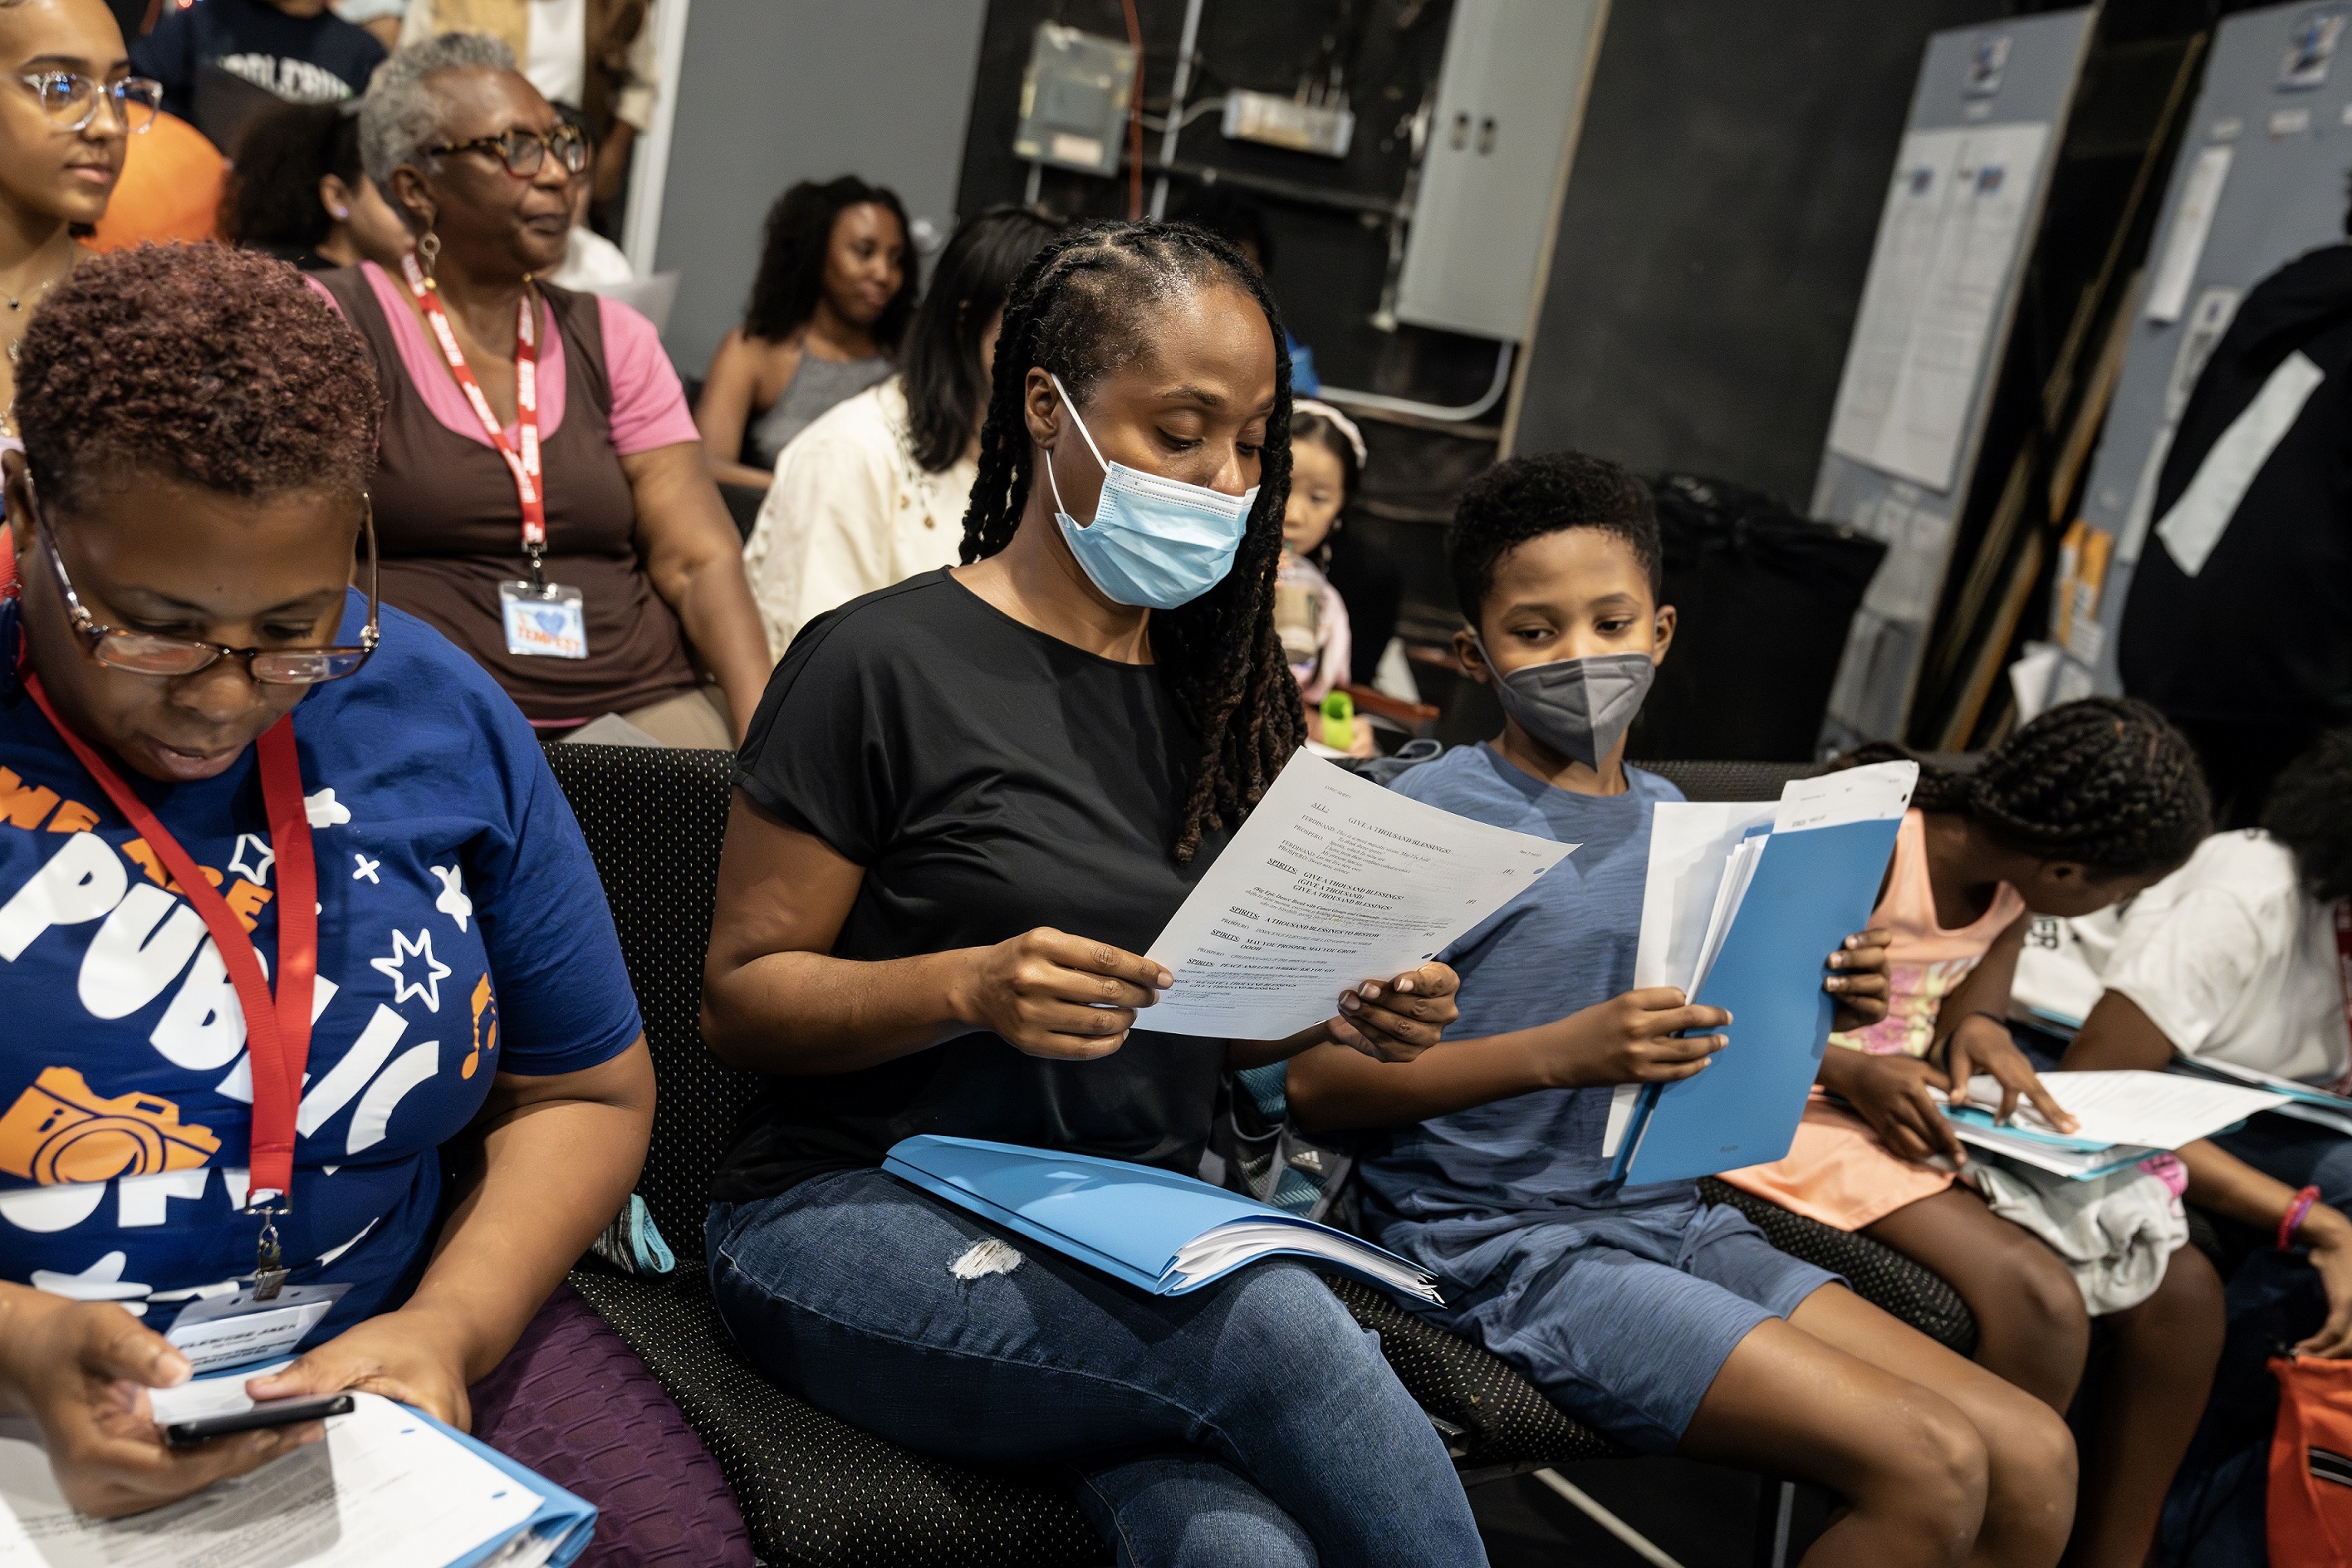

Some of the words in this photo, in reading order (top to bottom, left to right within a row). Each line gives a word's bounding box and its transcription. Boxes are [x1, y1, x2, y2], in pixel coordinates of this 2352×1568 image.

[1311, 803, 1330, 814] ALL:
[1348, 818, 1365, 828] GIVE
[1374, 828, 1412, 843] THOUSAND
[1412, 840, 1451, 854] BLESSINGS!
[1267, 859, 1297, 875] SPIRITS:
[1304, 872, 1323, 881] GIVE
[1330, 880, 1365, 893] THOUSAND
[1365, 889, 1404, 899] BLESSINGS!
[1298, 879, 1320, 889] (GIVE
[1326, 887, 1365, 899] THOUSAND)
[1293, 885, 1312, 894] GIVE
[1319, 893, 1355, 904] THOUSAND
[1355, 901, 1392, 910] BLESSINGS!
[1230, 906, 1260, 920] SPIRITS:
[1272, 919, 1309, 929] THOUSAND
[1309, 926, 1344, 934] BLESSINGS
[1211, 929, 1240, 942] SPIRITS:
